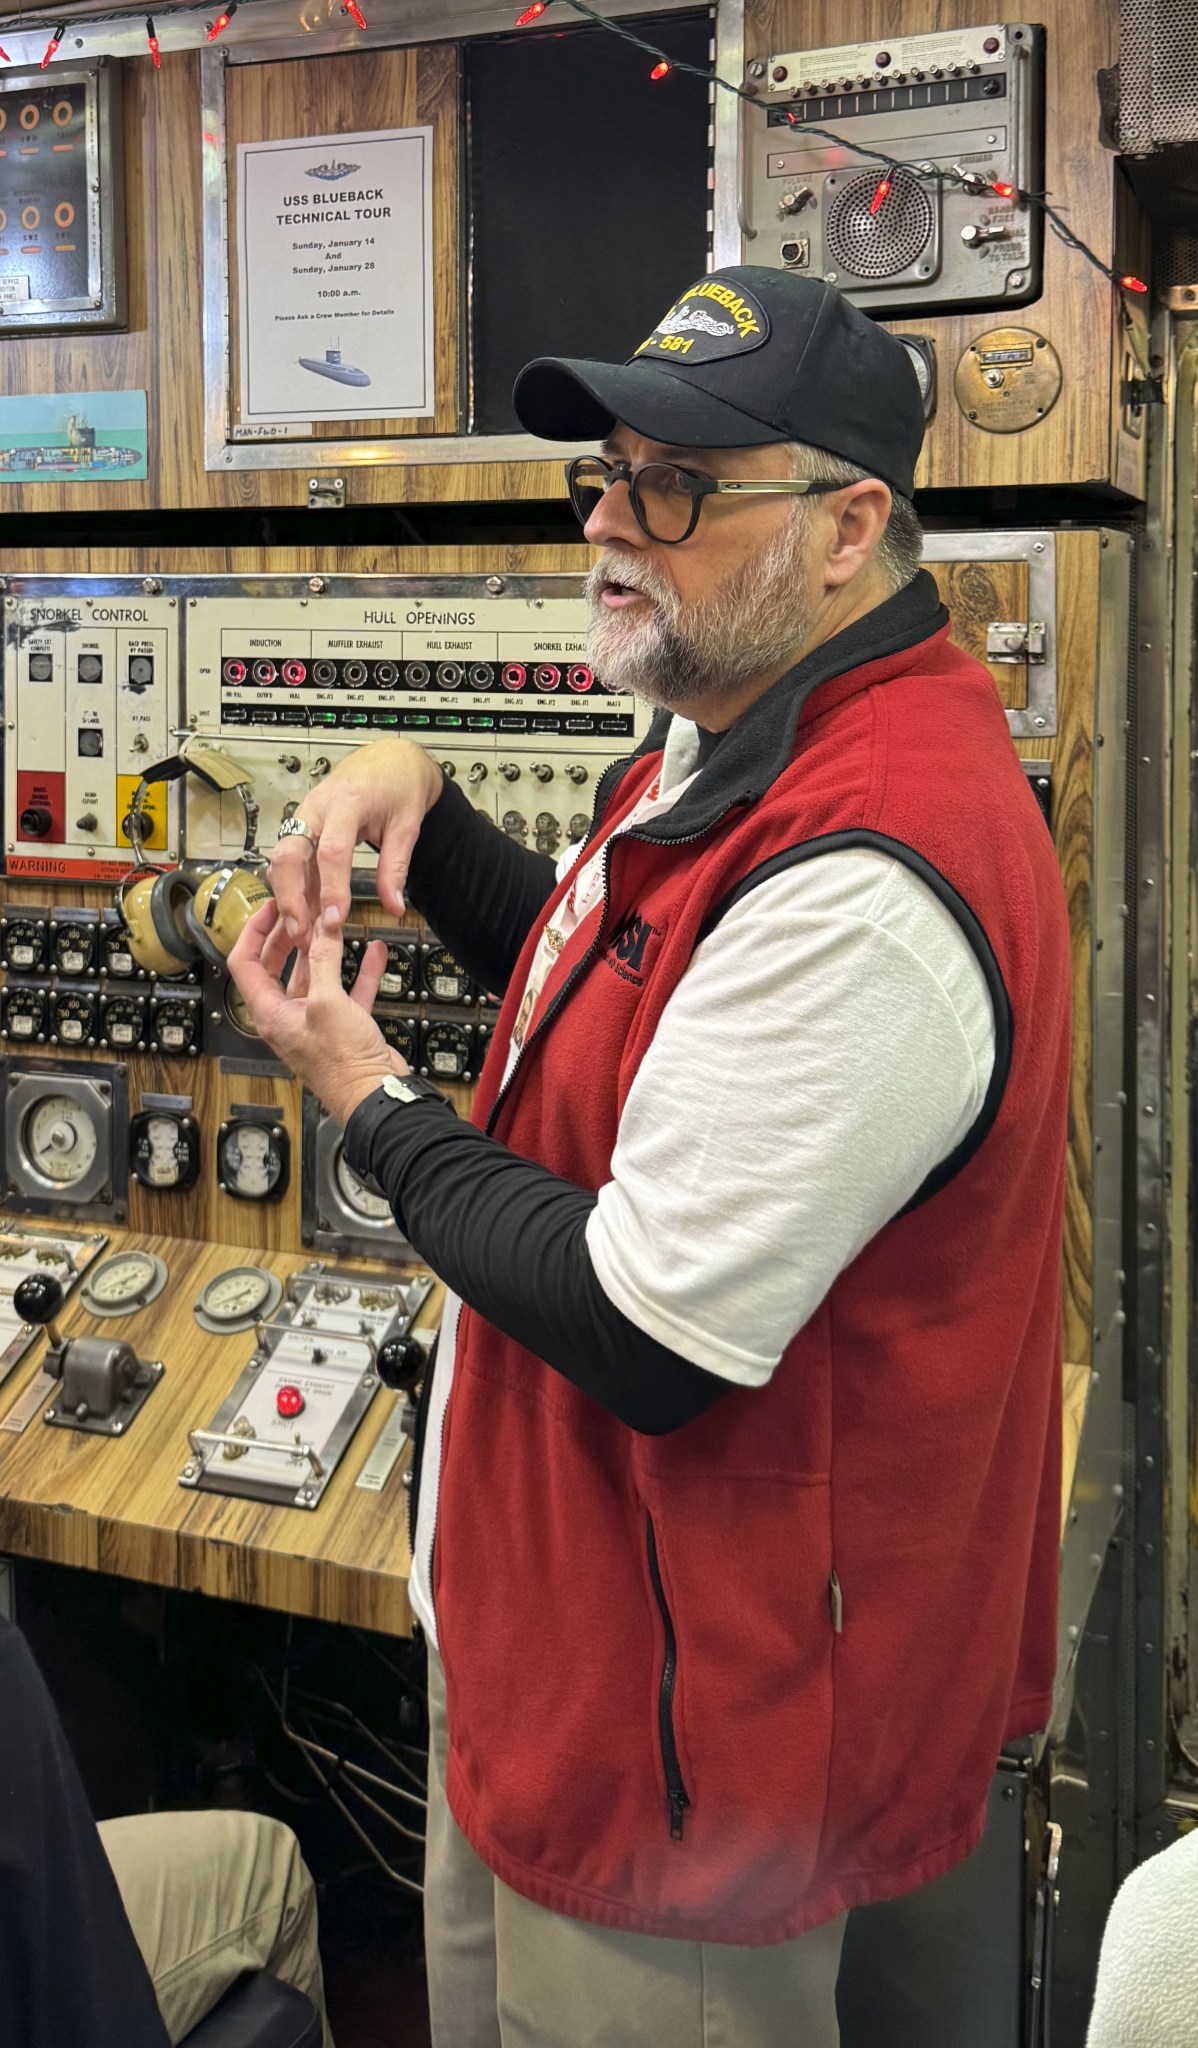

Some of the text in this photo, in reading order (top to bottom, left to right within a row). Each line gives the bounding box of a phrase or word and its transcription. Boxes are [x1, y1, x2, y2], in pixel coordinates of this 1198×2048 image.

[283, 189, 384, 206] USS BLUEBACK
[276, 207, 392, 226] TECHNICAL TOUR
[292, 238, 375, 251] Sunday, January 14
[325, 252, 342, 260] And
[292, 262, 375, 275] Sunday, January 28
[317, 289, 361, 298] 10:00 a.m.
[30, 608, 149, 622] SNORKEL CONTROL
[364, 611, 476, 625] HULL OPENINGS
[249, 639, 282, 648] INDUCTION
[328, 640, 384, 649] MUFFLER EXHAUST
[426, 641, 473, 650] HULL EXHAUST
[533, 642, 563, 651] SNORKEL
[9, 860, 66, 873] WARNING
